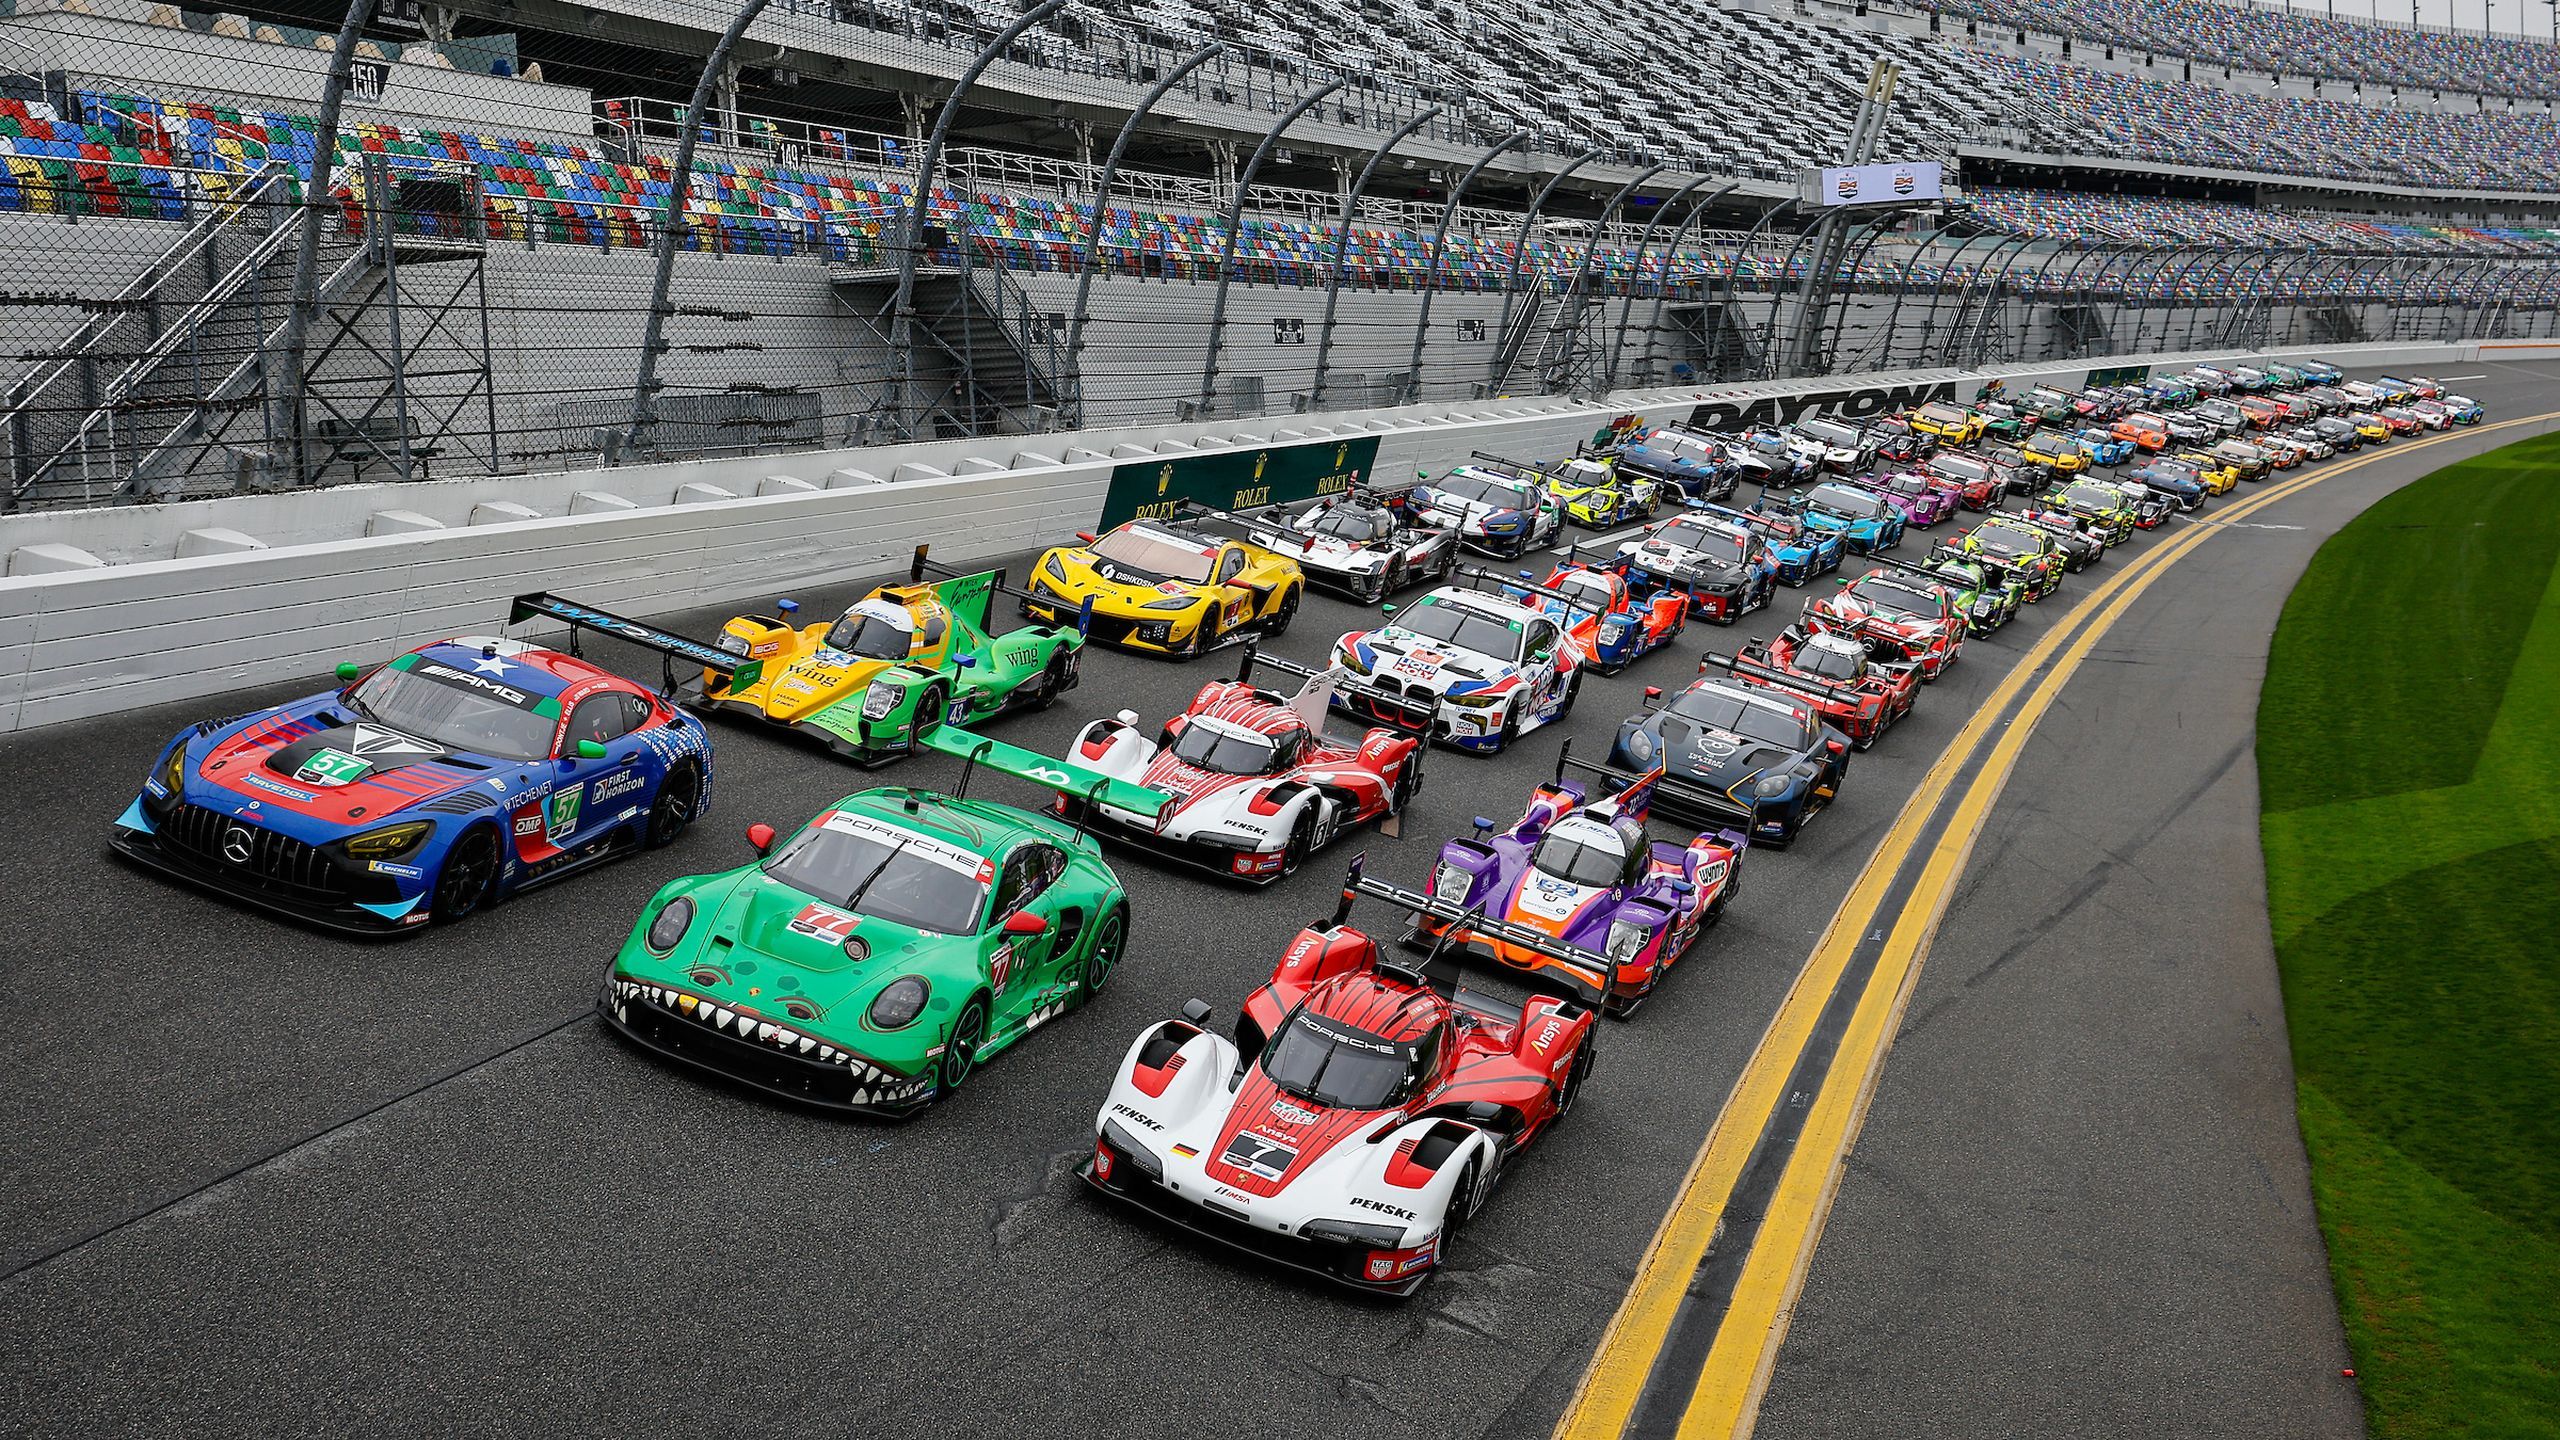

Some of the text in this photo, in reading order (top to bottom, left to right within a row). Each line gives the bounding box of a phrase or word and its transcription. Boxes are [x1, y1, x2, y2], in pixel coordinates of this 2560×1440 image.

[350, 63, 379, 100] 150
[781, 143, 799, 170] 149
[1688, 384, 1956, 434] DAYTONA
[1317, 474, 1348, 495] ROLEX
[1232, 486, 1270, 509] ROLEX
[1136, 500, 1177, 519] ROLEX
[1116, 571, 1155, 588] OSHKOSH
[1888, 581, 1936, 601] AMG
[1467, 605, 1508, 624] Motorsport
[1005, 644, 1040, 669] wing
[788, 664, 840, 688] wing
[1394, 663, 1434, 680] MOLY
[457, 671, 528, 704] AMG
[565, 700, 575, 717] ELLIS
[949, 703, 964, 726] 43
[1197, 717, 1265, 743] PORSCHE
[312, 754, 361, 777] 57
[606, 776, 645, 800] HORIZON
[608, 769, 632, 788] FIRST
[510, 780, 553, 809] TECHEMET
[554, 792, 581, 824] 57
[515, 817, 543, 833] OMP
[1223, 819, 1270, 837] PENSKE
[1315, 826, 1326, 846] 6
[1577, 822, 1617, 841] LMP2
[832, 814, 978, 869] PORSCHE
[384, 865, 418, 876] MICHELIN
[1540, 879, 1578, 896] 52
[805, 907, 850, 931] 77
[1286, 936, 1319, 968] Ansys
[993, 953, 1010, 987] 77
[1296, 1014, 1396, 1056] PORSCHE
[1530, 1019, 1562, 1057] Ansys
[1112, 1103, 1166, 1133] PENSKE
[1254, 1124, 1299, 1144] Ansys
[1249, 1140, 1276, 1161] 7
[1226, 1191, 1251, 1205] IMSA
[1349, 1197, 1418, 1222] PENSKE
[1374, 1260, 1393, 1268] TAG
